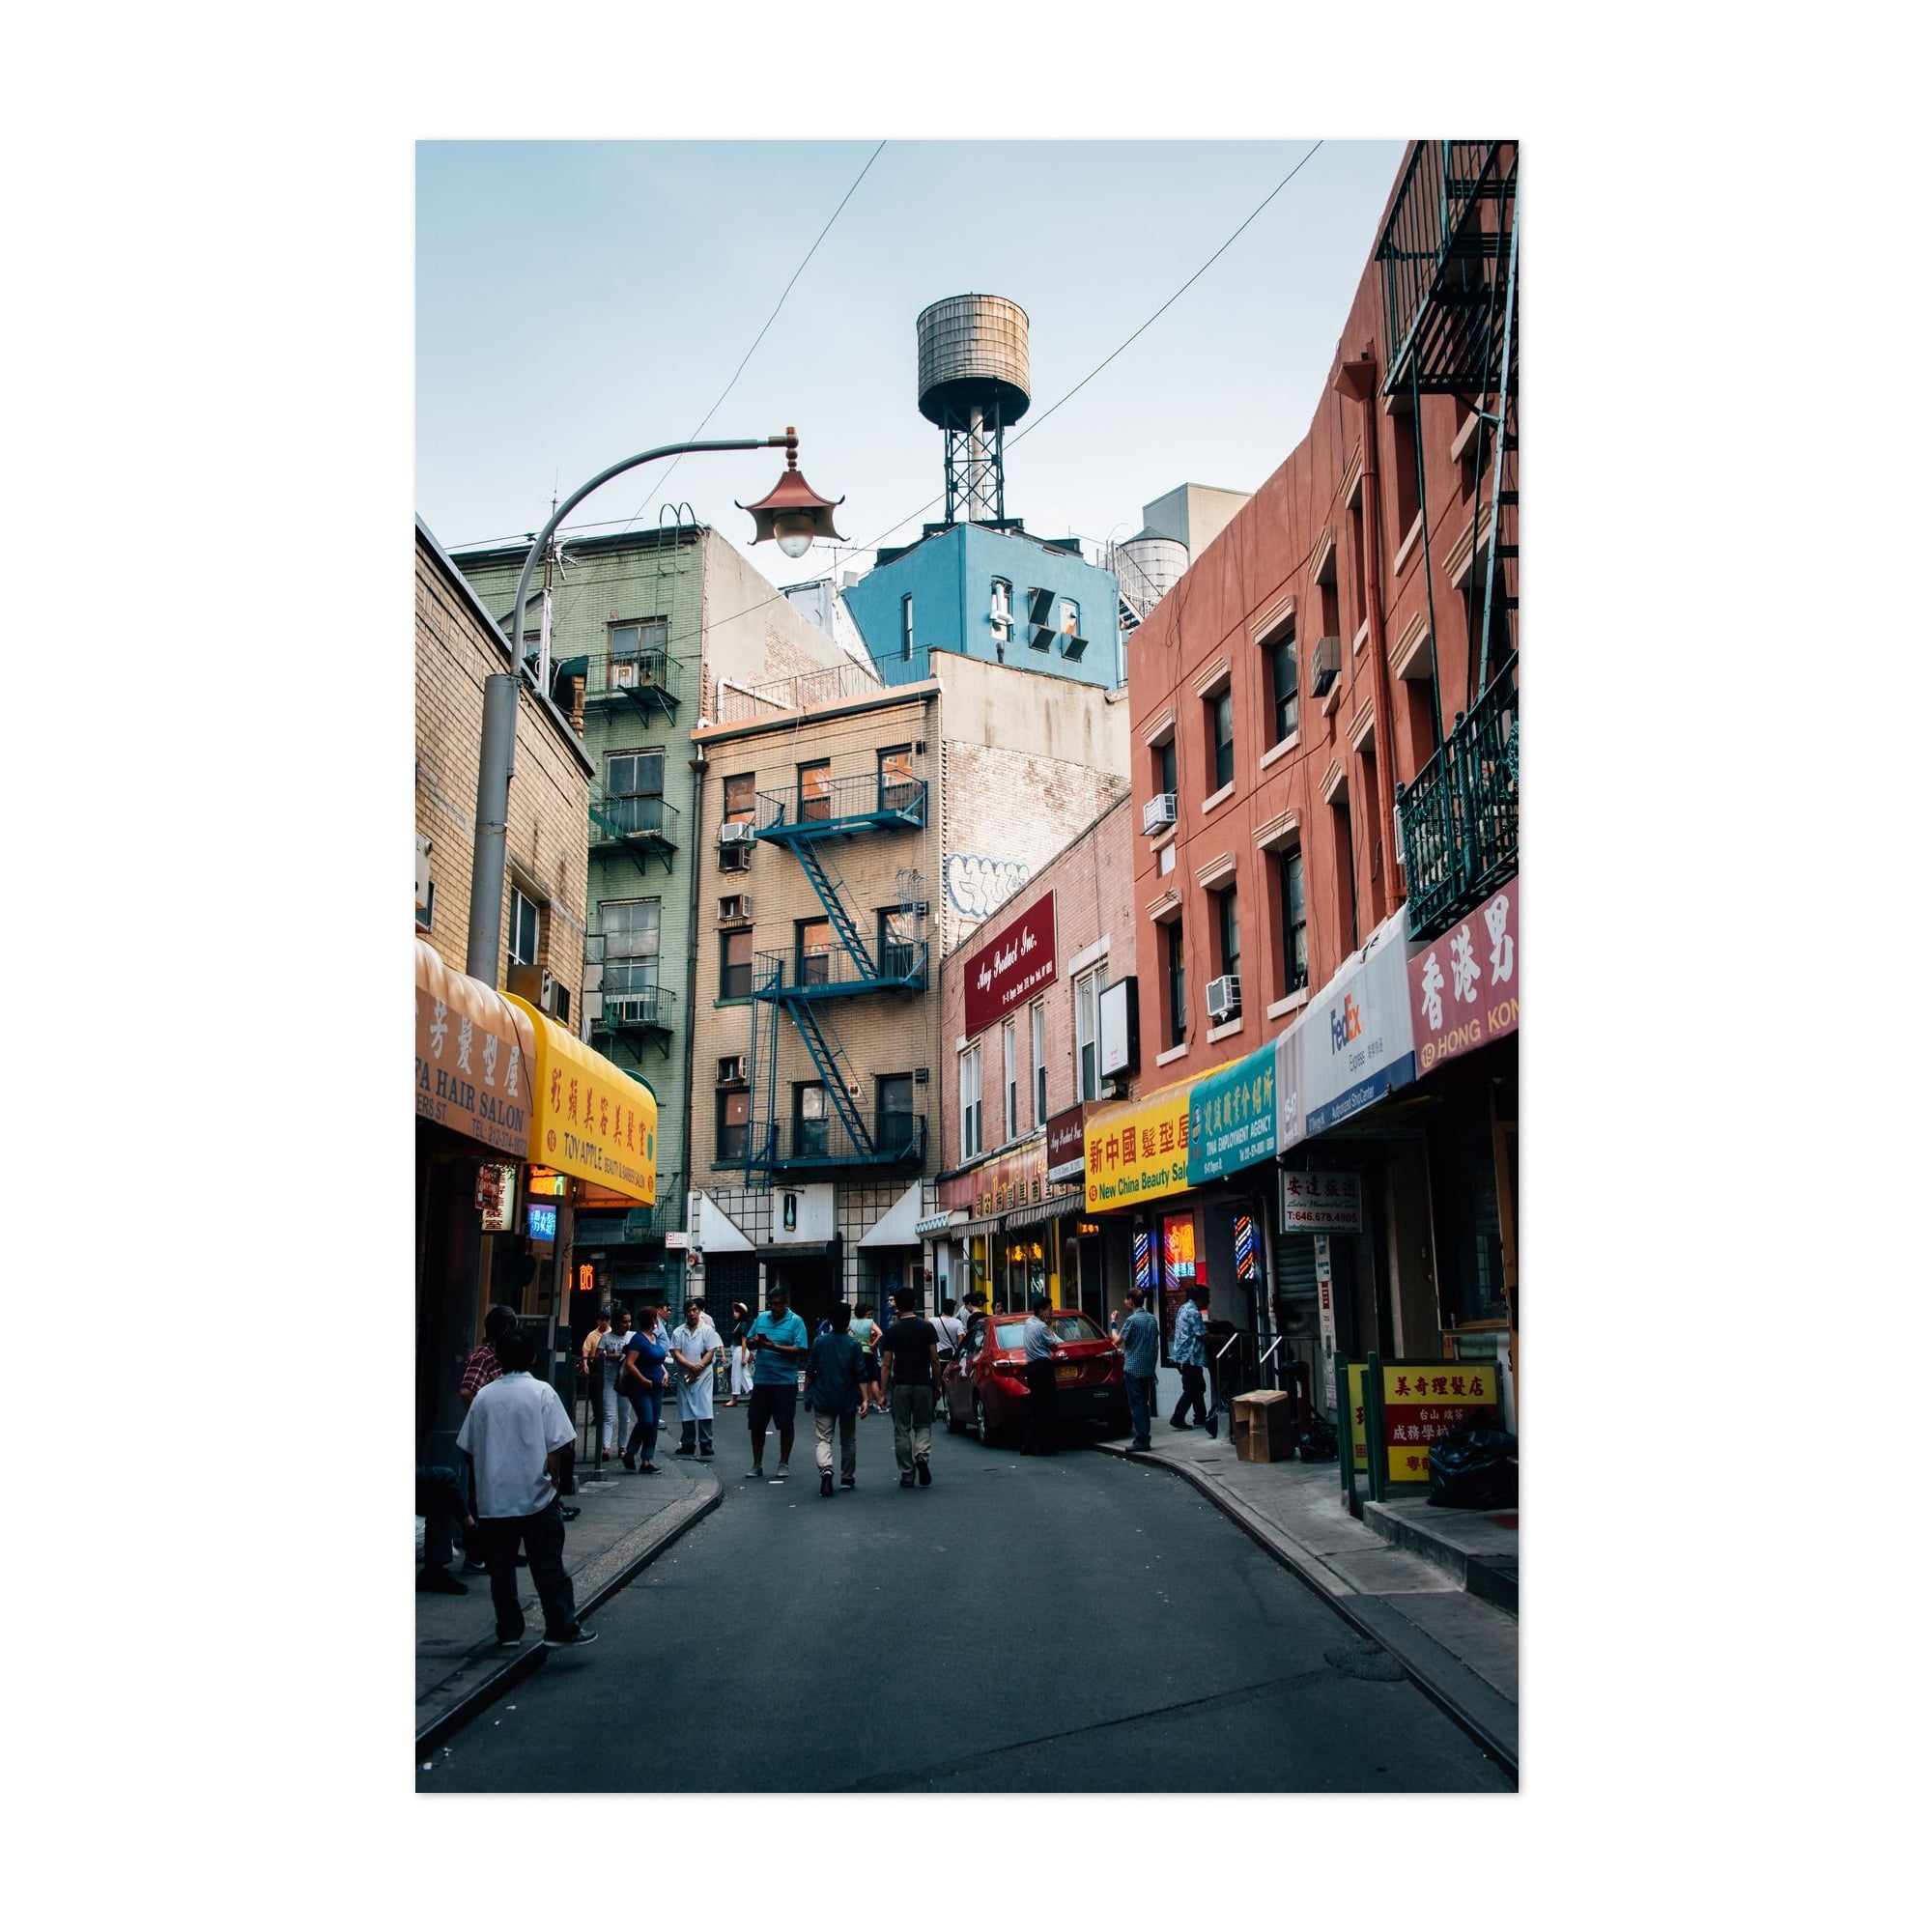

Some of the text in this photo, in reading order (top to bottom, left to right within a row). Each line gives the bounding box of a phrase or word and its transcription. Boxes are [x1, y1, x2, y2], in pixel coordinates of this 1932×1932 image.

[1422, 895, 1514, 1031] 香港男
[1330, 993, 1361, 1055] FedEx
[1437, 1019, 1481, 1060] HONG
[415, 998, 520, 1097] 芳髮型屋
[436, 1068, 476, 1113] HAIR
[479, 1092, 526, 1133] SALON
[564, 1132, 581, 1160] TOY
[581, 1140, 603, 1171] APPLE
[1218, 1124, 1249, 1152] EMPLOYMENT
[1250, 1114, 1272, 1139] AGENCY
[1099, 1183, 1116, 1200] New
[1118, 1176, 1139, 1196] China
[1142, 1168, 1169, 1190] Beauty
[1395, 1377, 1484, 1397] 美奇理髮店
[1393, 1425, 1456, 1441] 成務學校
[1419, 1408, 1439, 1421] 台山
